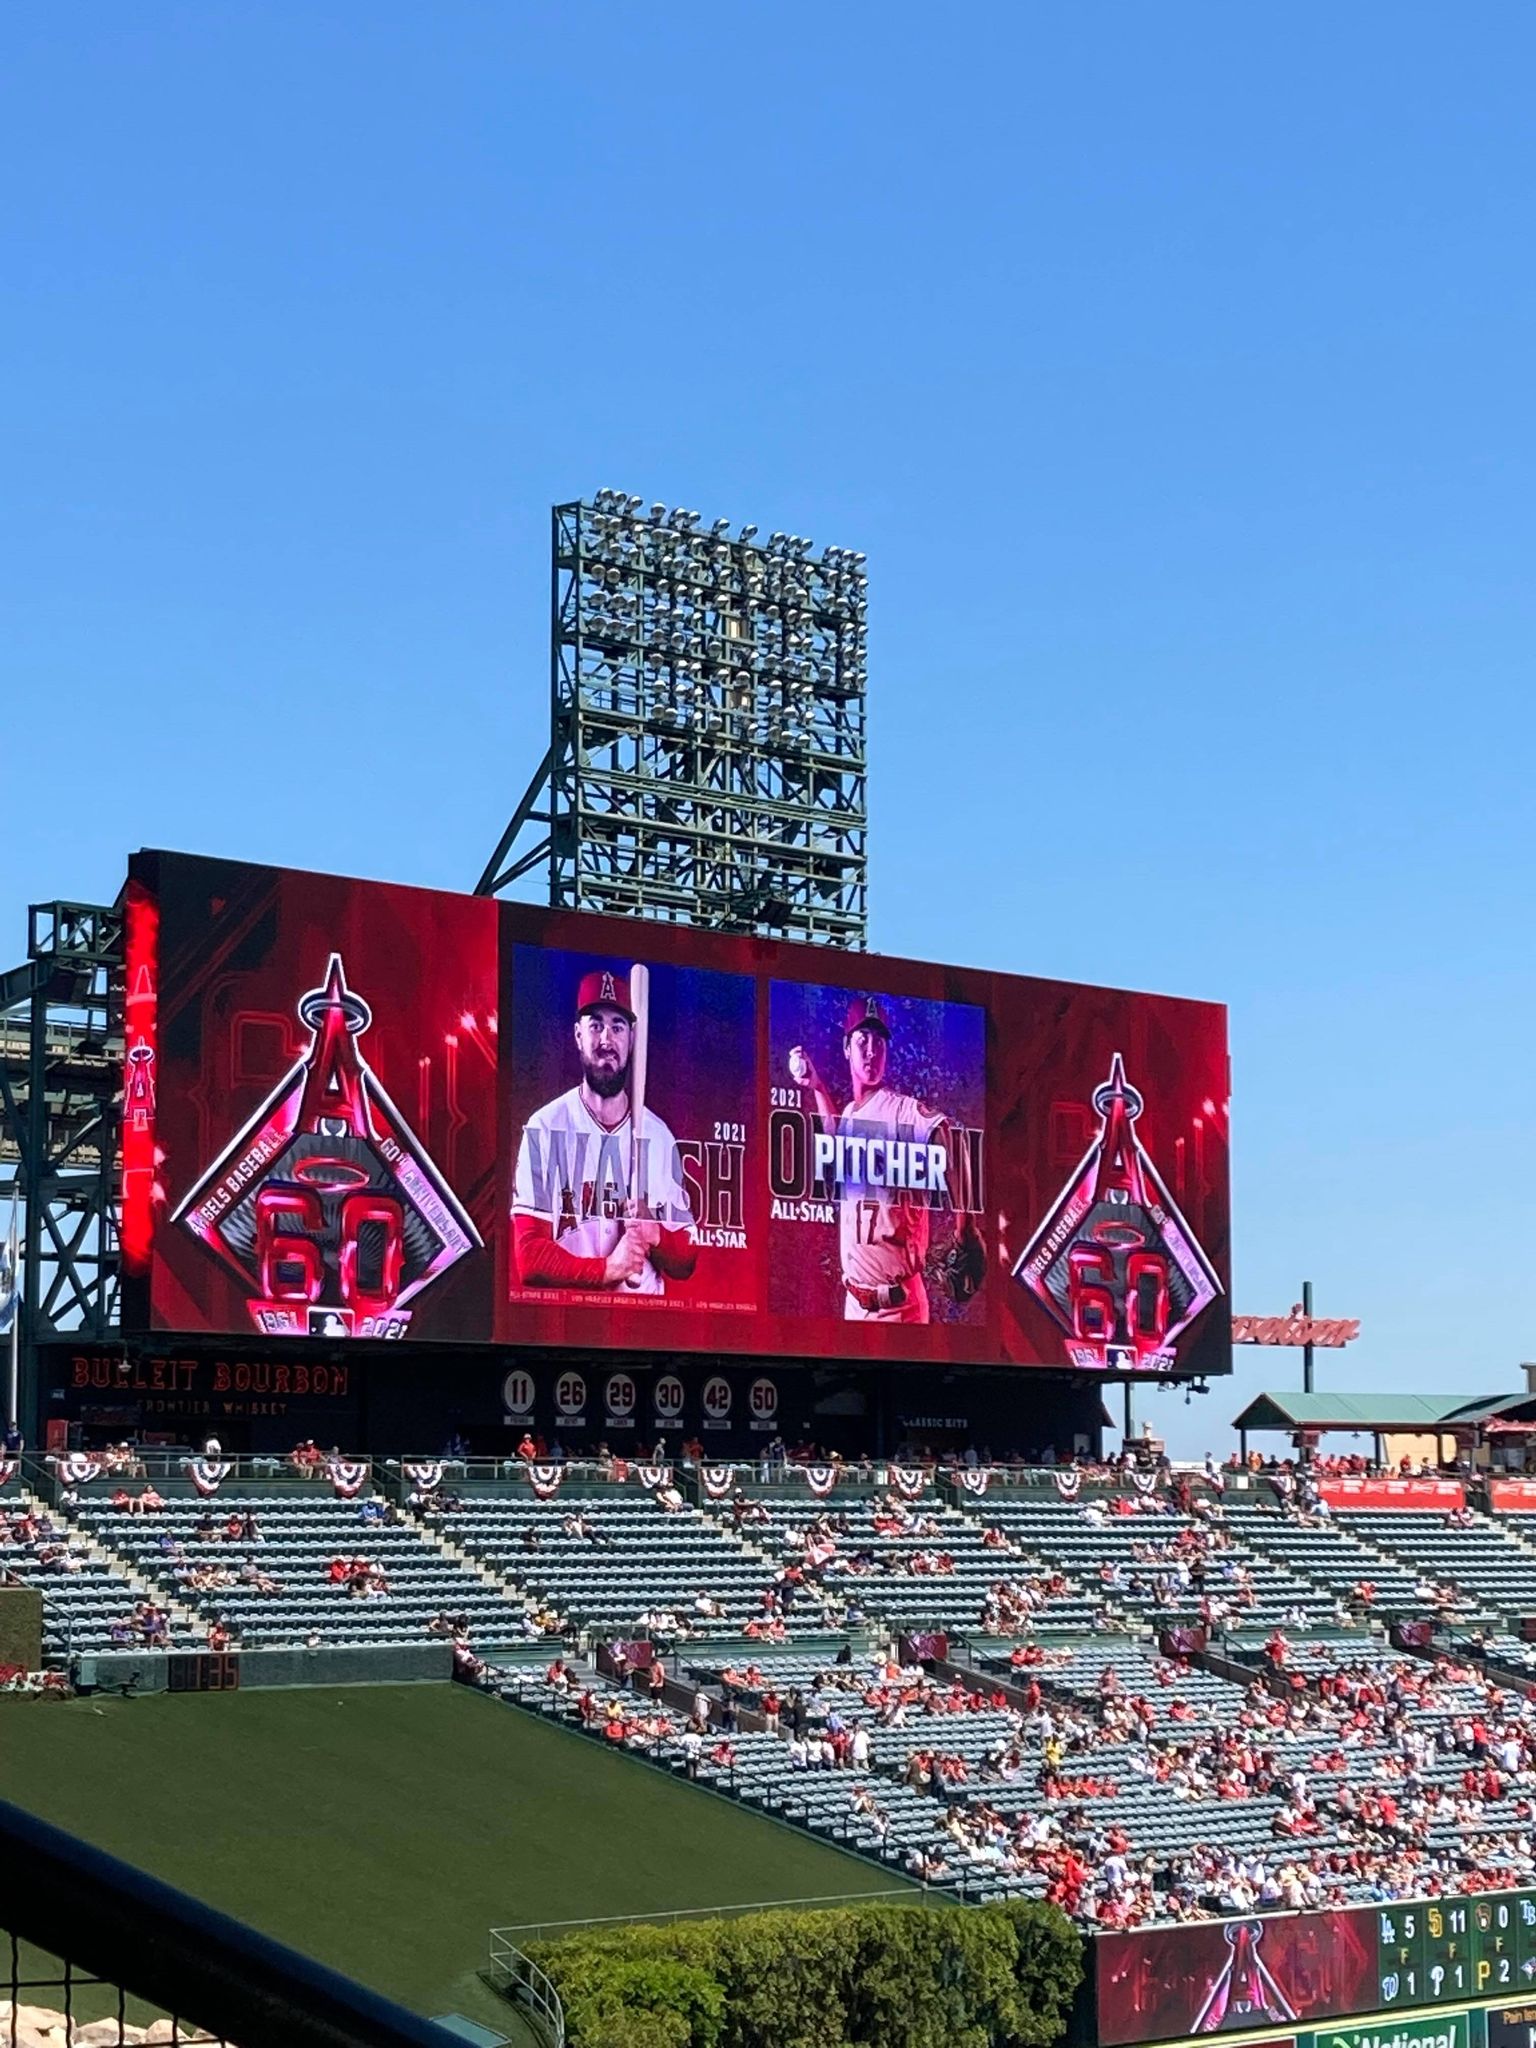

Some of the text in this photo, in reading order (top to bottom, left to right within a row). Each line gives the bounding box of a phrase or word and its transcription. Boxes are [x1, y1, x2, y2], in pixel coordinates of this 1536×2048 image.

[771, 1087, 802, 1108] 2021
[714, 1122, 746, 1142] 2021
[224, 1126, 286, 1193] BASEBALL
[814, 1133, 948, 1191] PITCHER
[524, 1127, 745, 1230] WALSH
[856, 1200, 881, 1245] 17
[256, 1183, 404, 1302] 60
[1069, 1241, 1170, 1342] 60
[71, 1357, 348, 1395] BULLEIT BOURBON
[511, 1378, 527, 1405] 11
[559, 1380, 583, 1406] 26
[609, 1381, 633, 1407] 29
[658, 1383, 681, 1408] 30
[706, 1385, 728, 1410] 42
[753, 1386, 774, 1411] 50
[1404, 1915, 1415, 1939] 5
[1449, 1909, 1466, 1933] 11
[1499, 1905, 1508, 1928] 0
[1400, 1947, 1409, 1965] F
[1448, 1942, 1457, 1959] F
[1495, 1936, 1504, 1952] F
[1407, 1971, 1415, 1995] 1
[1455, 1965, 1463, 1988] 1
[1478, 1959, 1510, 1990] P 2
